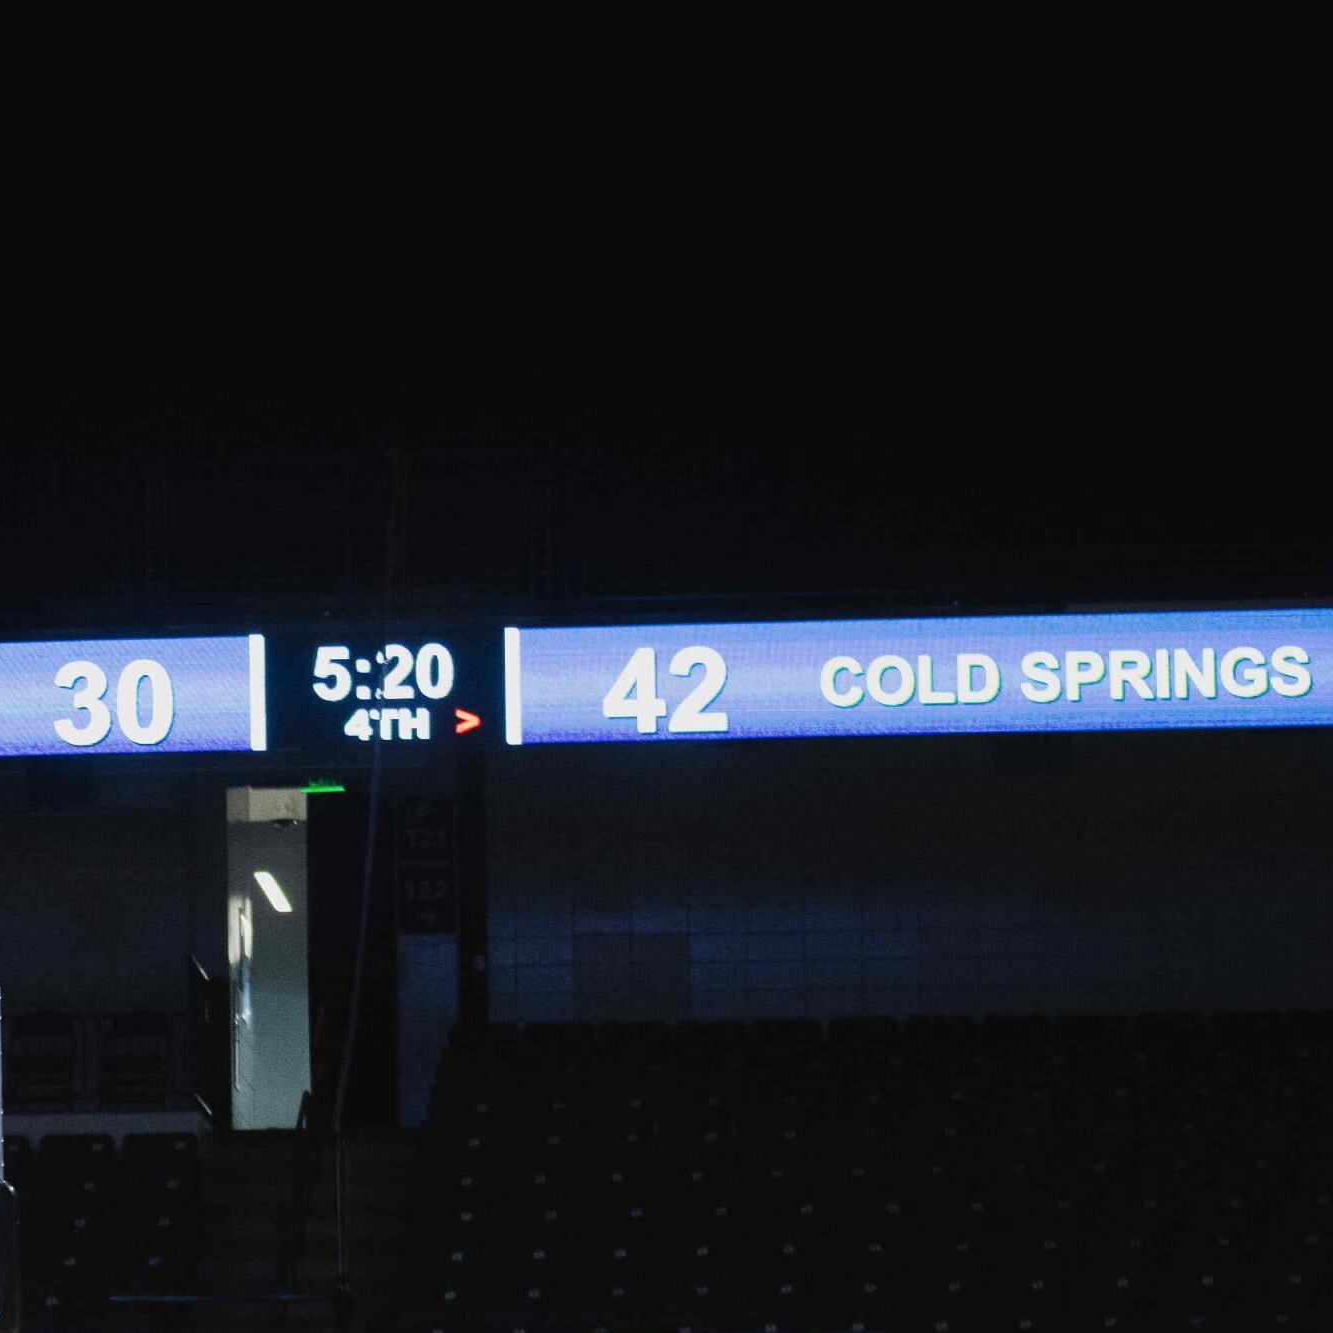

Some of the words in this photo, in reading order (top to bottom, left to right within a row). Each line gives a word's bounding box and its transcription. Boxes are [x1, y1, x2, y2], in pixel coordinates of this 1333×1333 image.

[52, 658, 175, 747] 30
[313, 643, 455, 702] 5:20
[602, 646, 730, 734] 42
[820, 654, 1001, 707] COLD
[1020, 645, 1312, 704] SPRINGS
[344, 707, 431, 741] 4TH
